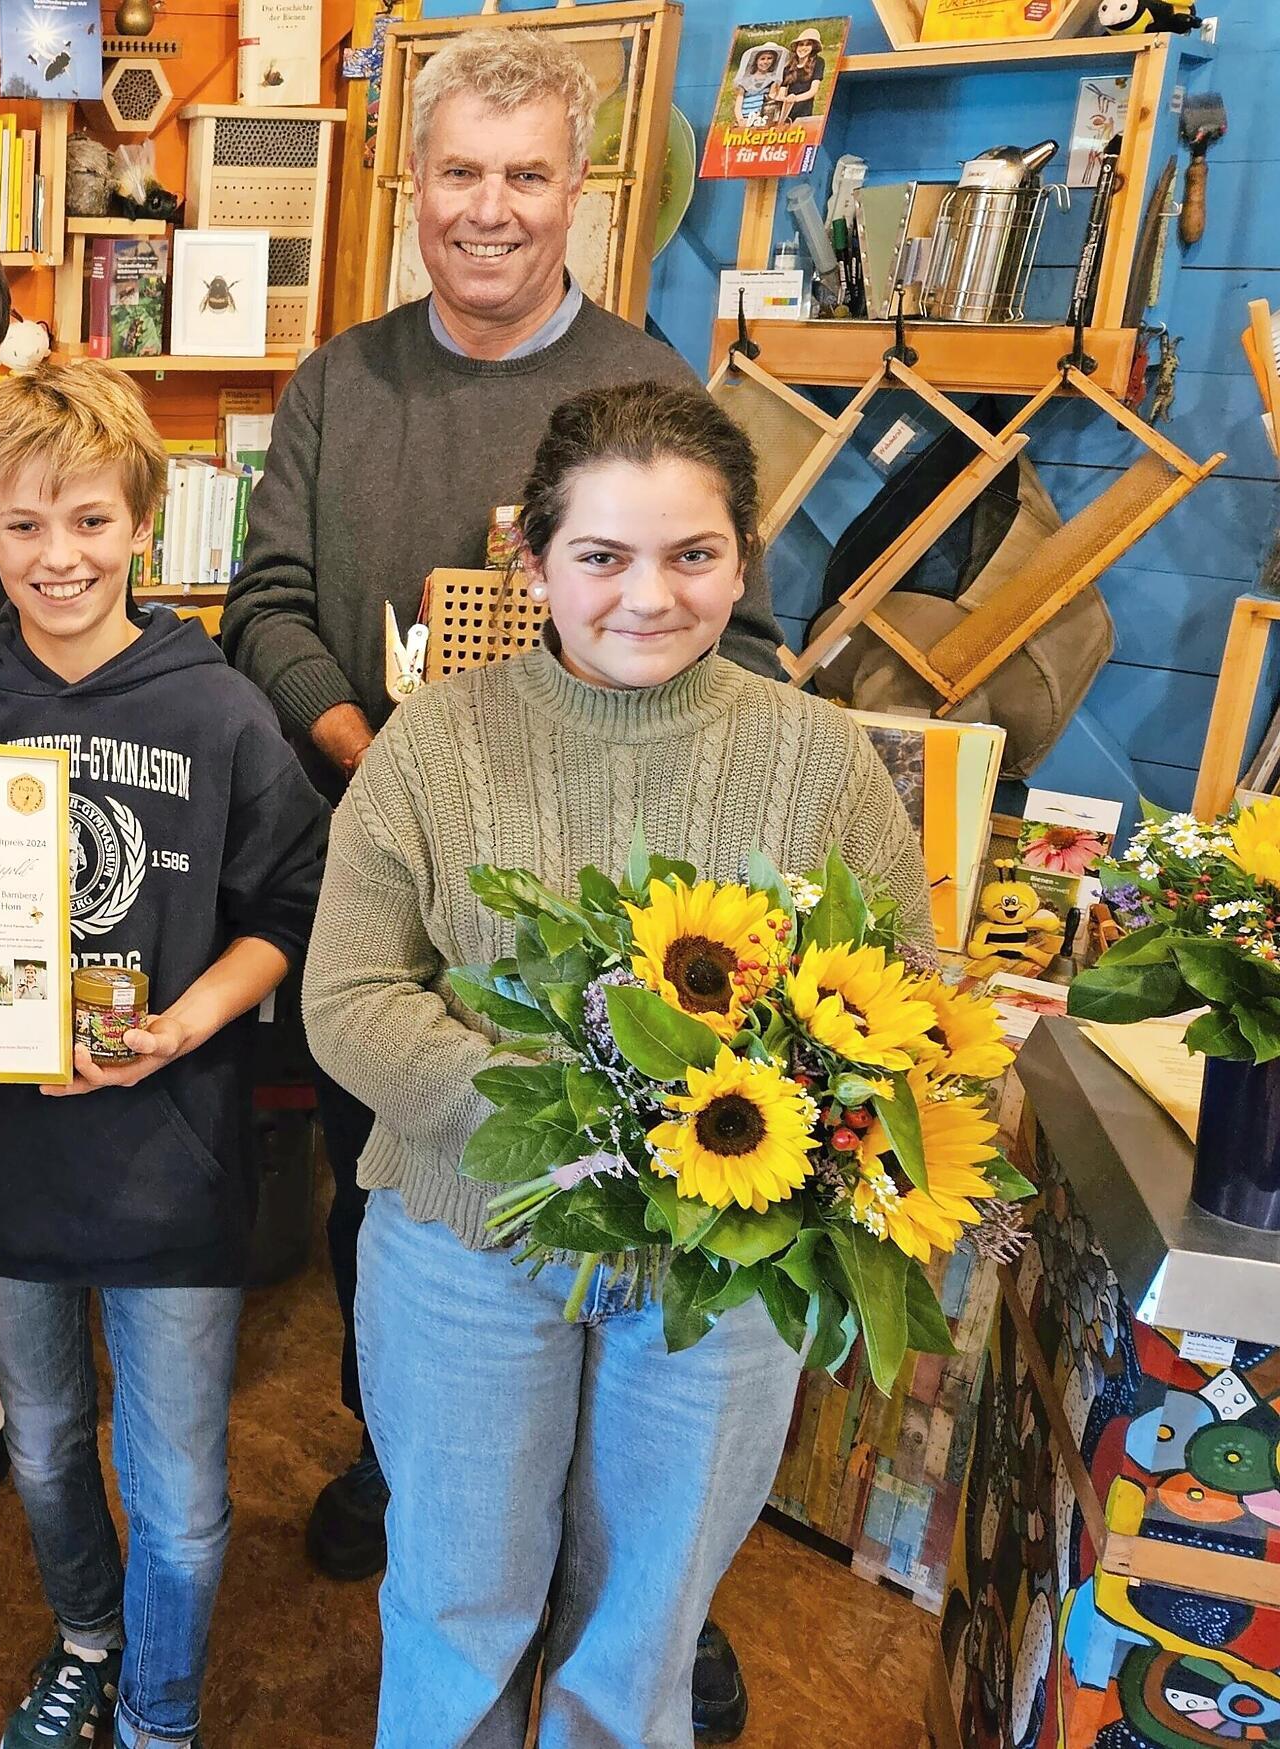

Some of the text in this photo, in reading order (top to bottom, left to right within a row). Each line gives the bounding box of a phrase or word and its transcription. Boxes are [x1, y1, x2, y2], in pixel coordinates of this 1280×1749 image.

[746, 113, 768, 127] Das
[723, 126, 807, 147] Imkerbuch
[736, 146, 789, 163] für Kids
[26, 839, 47, 848] 2024
[151, 850, 191, 873] 1586
[1, 890, 37, 902] Bamberg
